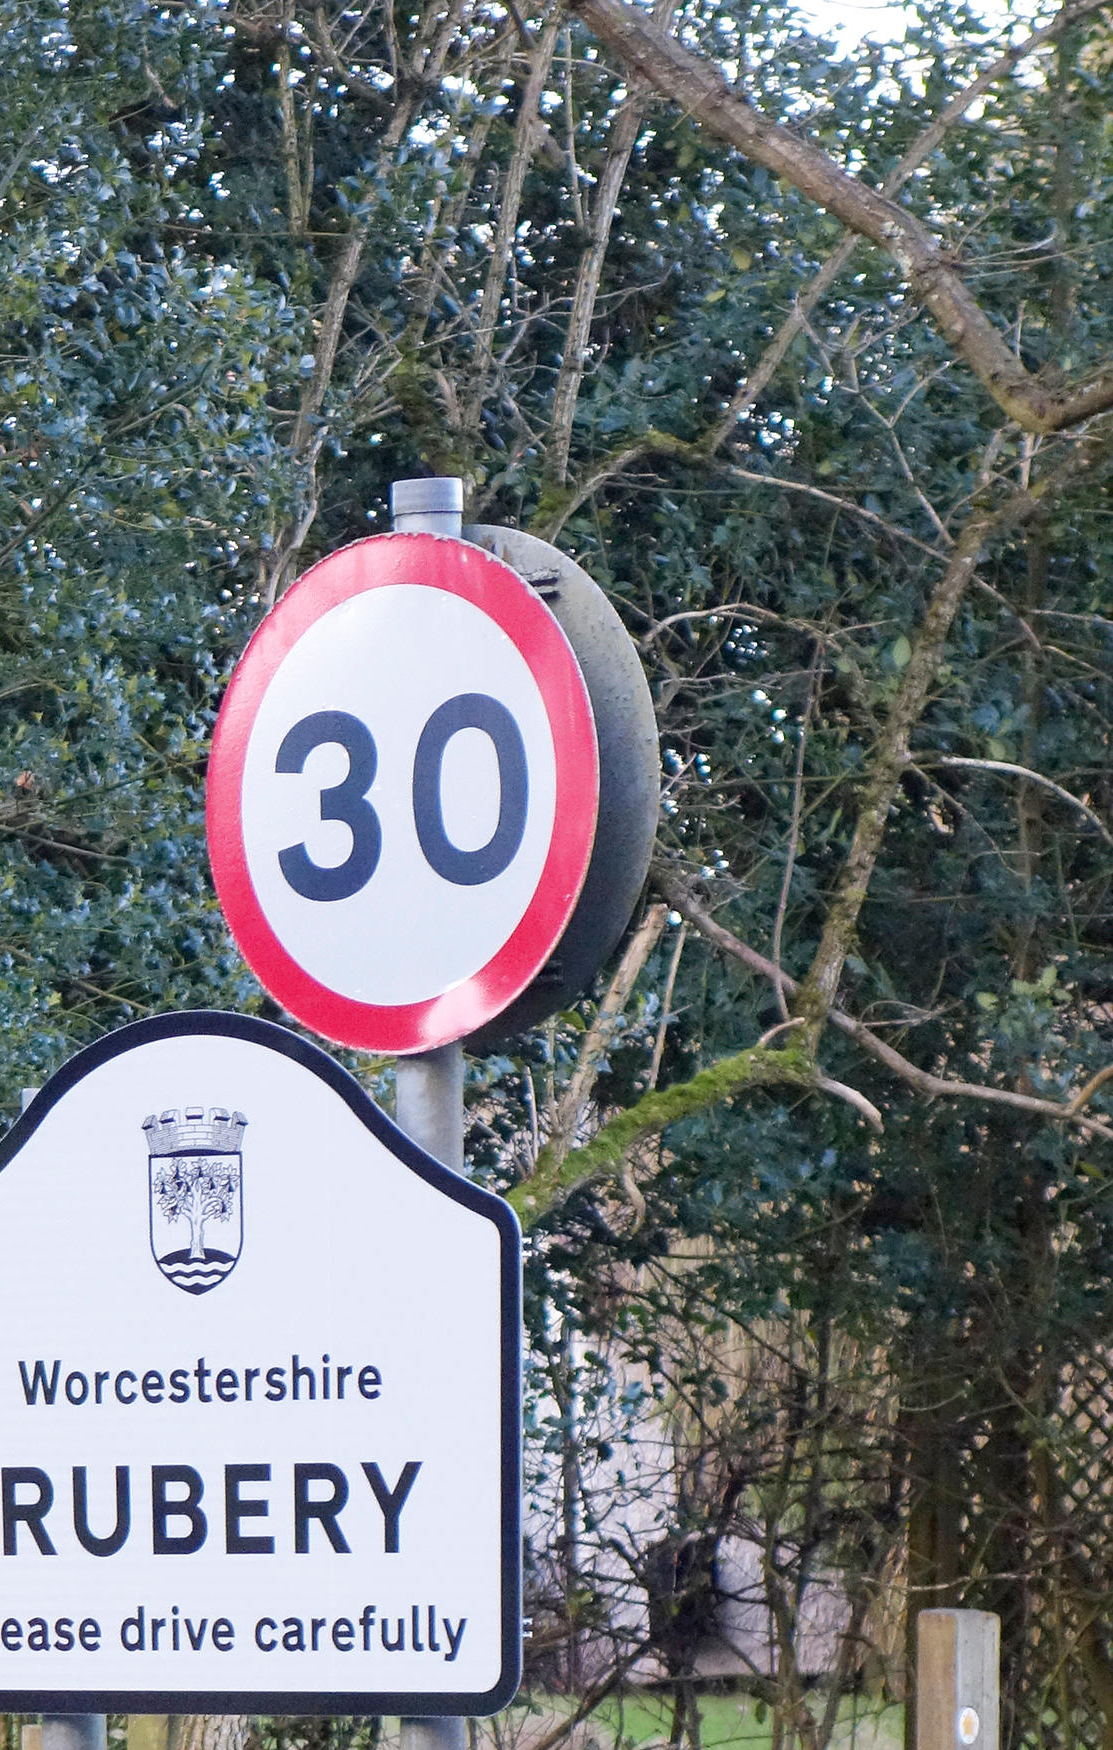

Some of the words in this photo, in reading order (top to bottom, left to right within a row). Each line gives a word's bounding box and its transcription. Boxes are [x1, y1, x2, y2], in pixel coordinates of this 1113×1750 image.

[274, 692, 531, 902] 30
[19, 1354, 383, 1406] Worcestershire
[1, 1460, 424, 1558] RUBERY
[120, 1605, 235, 1652] drive
[254, 1604, 468, 1662] carefully
